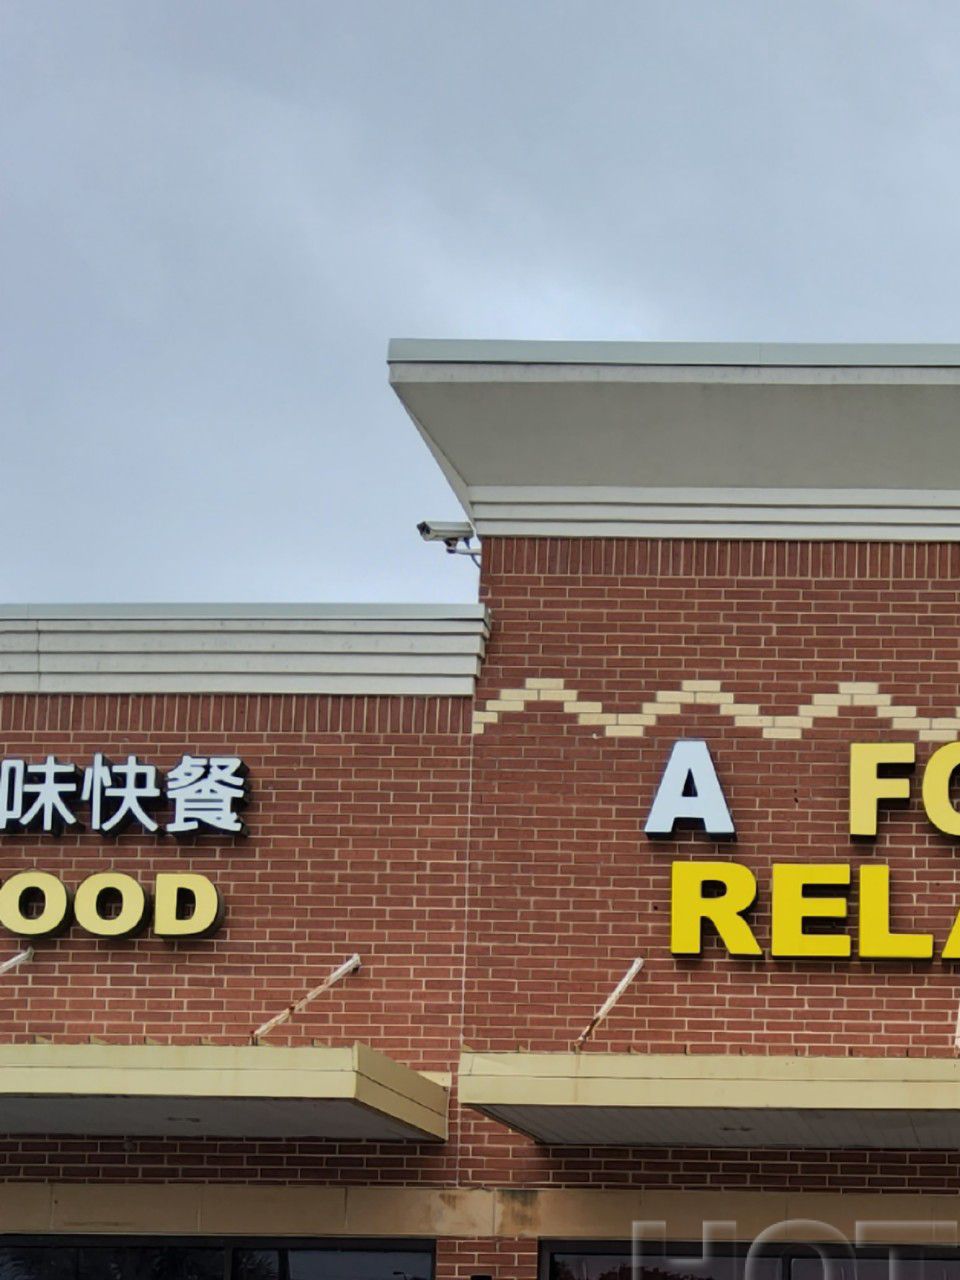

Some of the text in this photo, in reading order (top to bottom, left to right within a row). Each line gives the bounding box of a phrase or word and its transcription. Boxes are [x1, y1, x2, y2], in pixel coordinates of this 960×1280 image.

[0, 752, 246, 832] 味快餐
[644, 740, 735, 835] A
[0, 870, 219, 937] OOD
